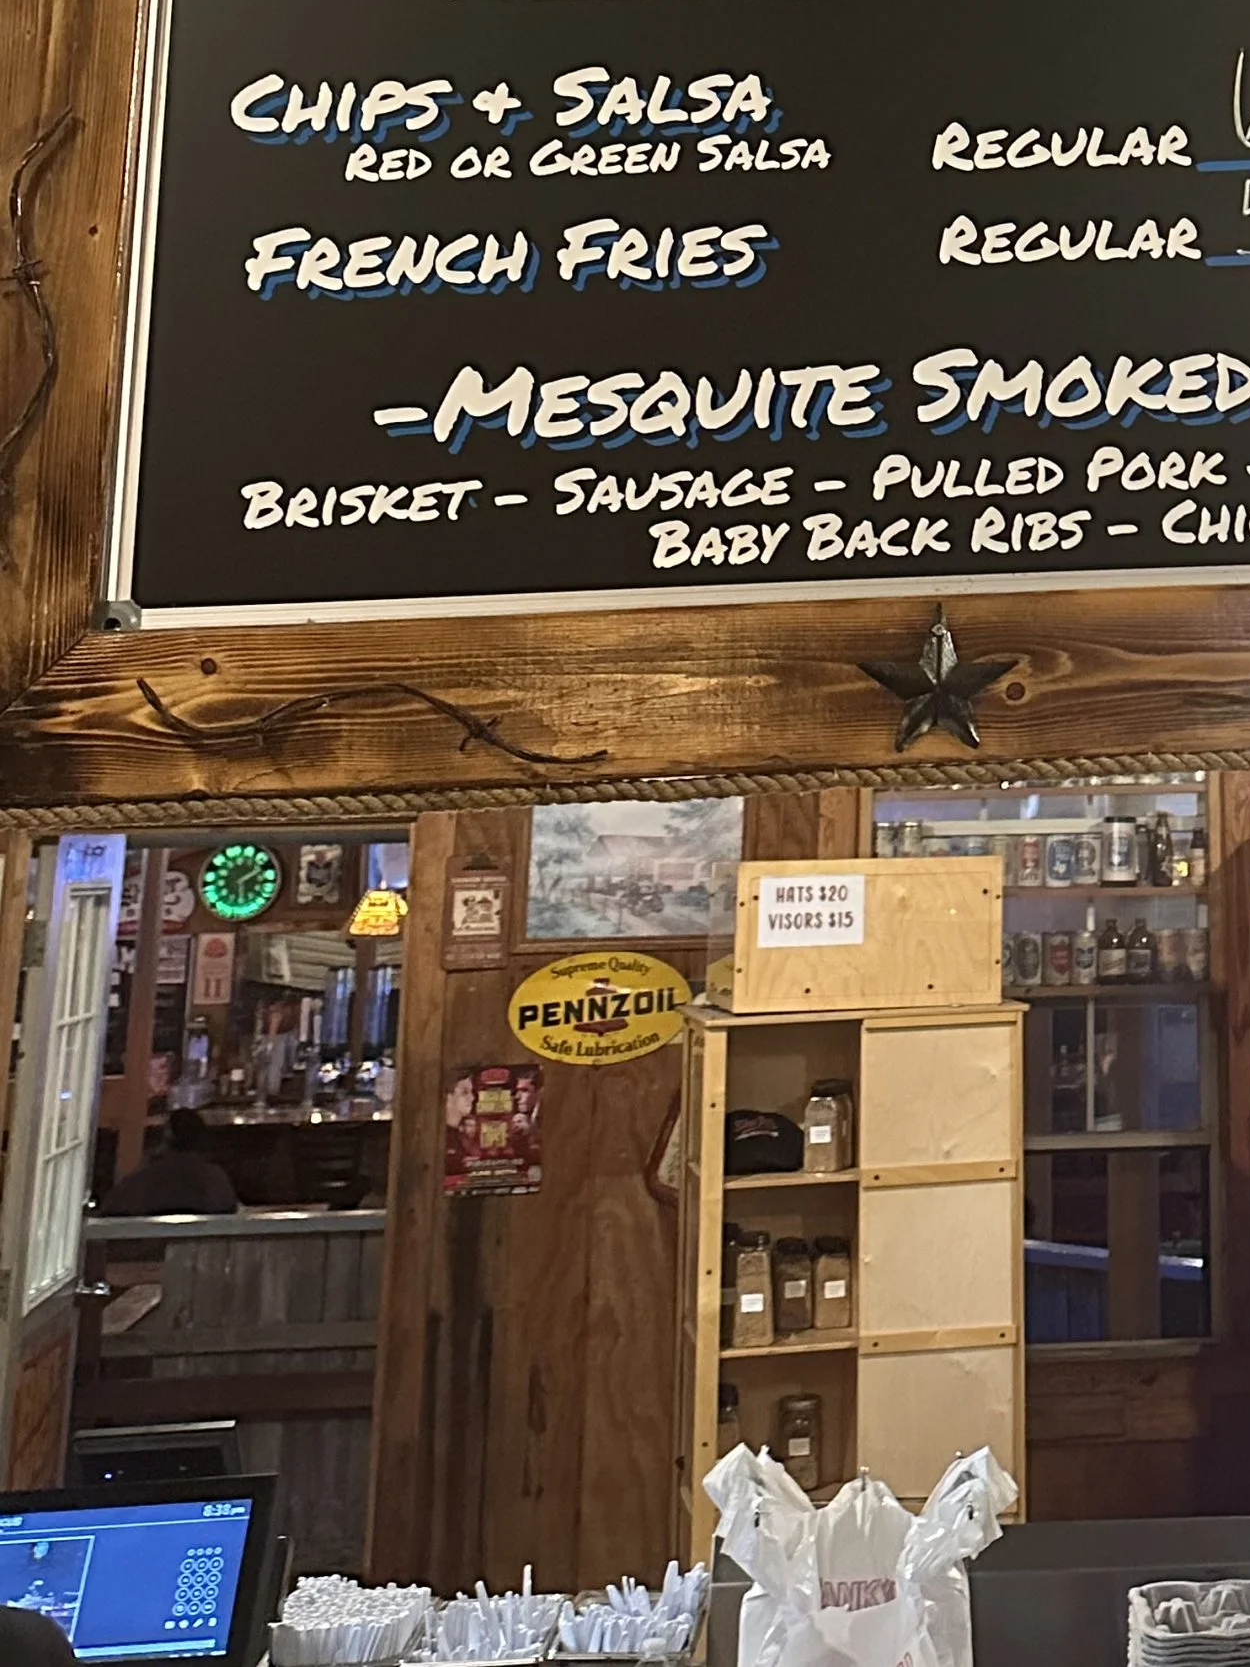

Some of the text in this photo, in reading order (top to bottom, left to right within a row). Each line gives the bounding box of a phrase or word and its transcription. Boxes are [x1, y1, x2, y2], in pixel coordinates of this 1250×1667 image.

[231, 75, 452, 133] CHIPS
[554, 67, 771, 126] SALSA
[932, 122, 1191, 171] REGULAR
[345, 135, 831, 181] RED OR GREEN SALSA
[245, 228, 527, 290] FRENCH
[557, 219, 767, 280] FRIES
[940, 215, 1201, 265] REGULAR
[241, 480, 482, 529] BRISKET
[555, 467, 793, 514] SAUSAGE
[873, 455, 1063, 500] PULLED
[1087, 447, 1227, 492] PORK
[649, 520, 790, 568] BABY
[803, 513, 950, 560] BACK
[971, 507, 1091, 553] RIBS
[775, 885, 848, 903] HATS $20
[768, 911, 854, 930] VISORS $15
[551, 956, 651, 979] Supreme Quality
[518, 987, 687, 1031] PENNZOIL
[541, 1031, 660, 1057] Safe Lubrication
